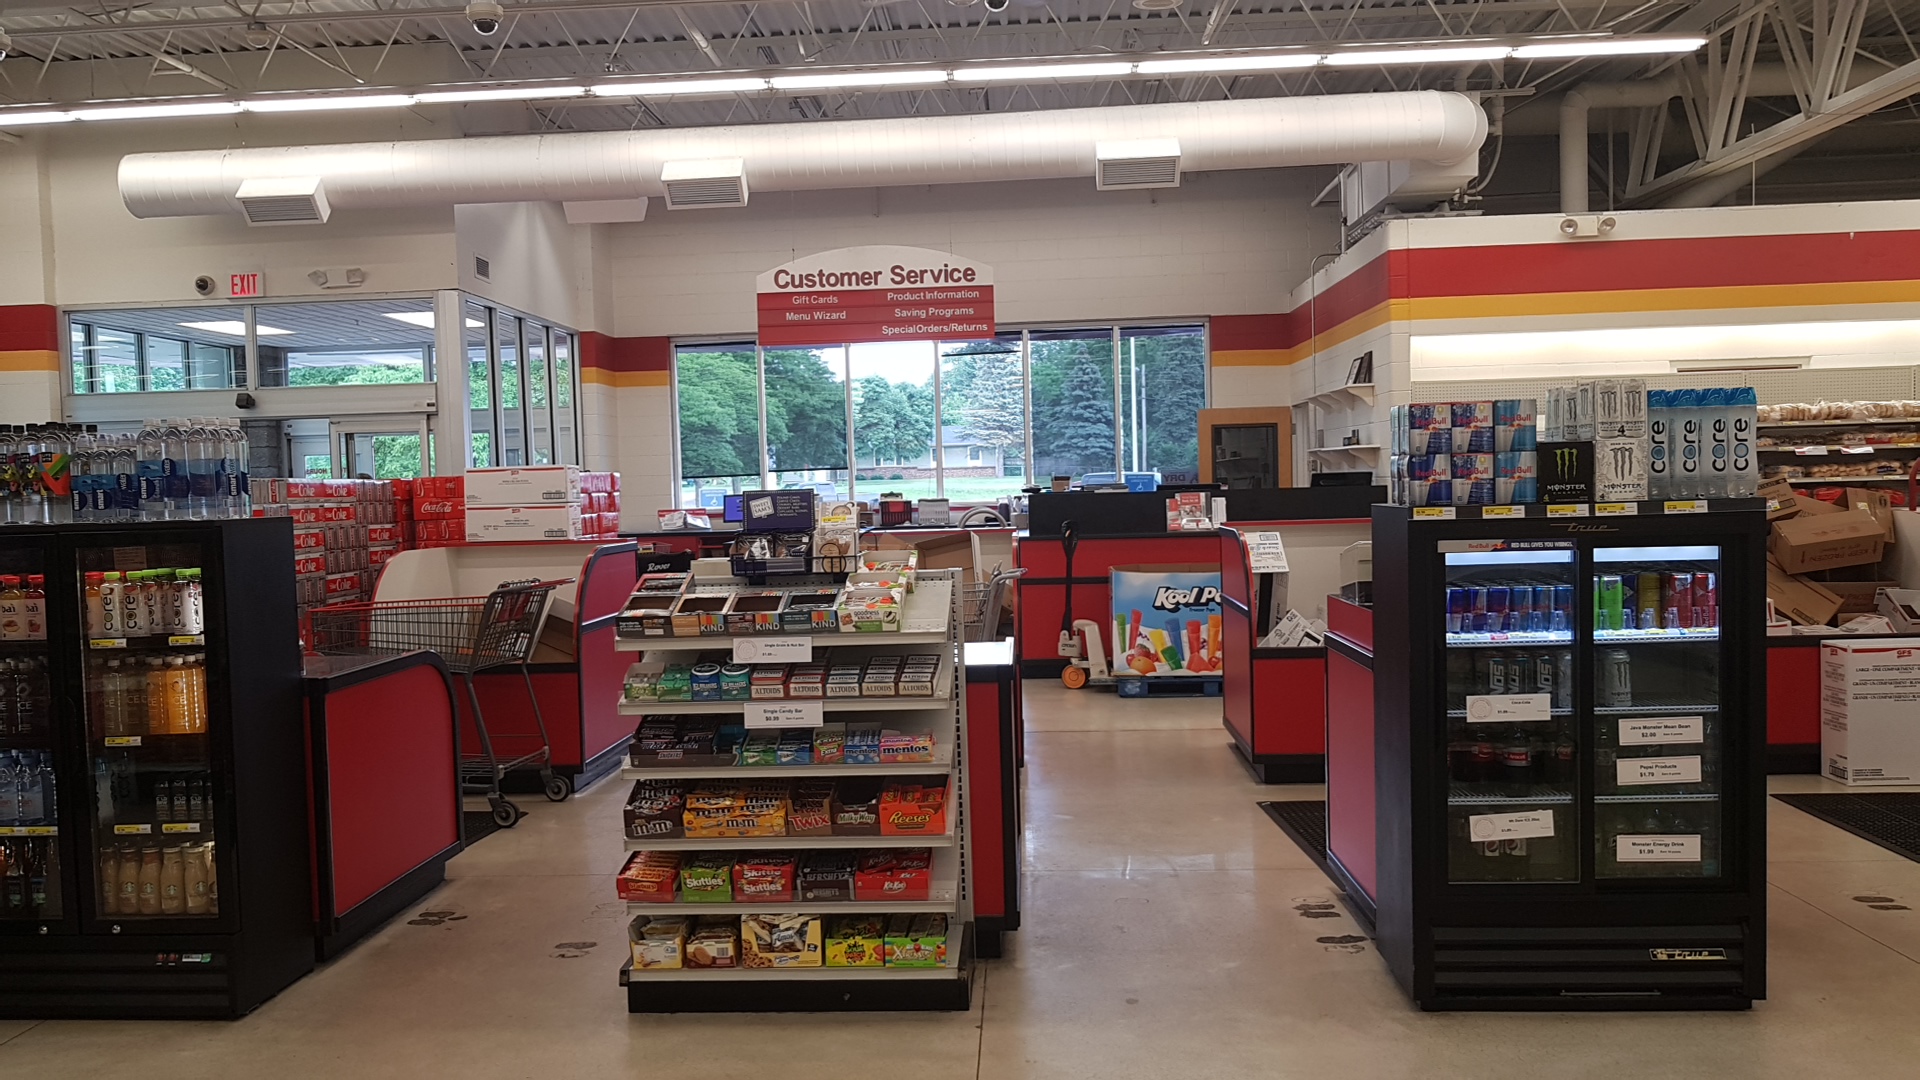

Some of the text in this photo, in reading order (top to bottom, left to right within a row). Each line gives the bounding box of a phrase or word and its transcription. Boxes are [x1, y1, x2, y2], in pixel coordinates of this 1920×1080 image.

[774, 264, 976, 289] Customer Service
[230, 274, 258, 296] EXIT
[792, 295, 838, 304] Gift Cards
[887, 290, 979, 301] Product Information
[786, 310, 846, 321] Menu Wizard
[894, 307, 974, 319] Saving Programs
[1651, 420, 1666, 474] core
[1682, 420, 1696, 473] core
[1712, 418, 1726, 472] core
[1734, 418, 1749, 472] core
[421, 502, 452, 513] Coca-Cola
[647, 563, 670, 572] Rover
[1154, 587, 1197, 609] Kool
[104, 596, 113, 631] core
[125, 596, 137, 629] core
[700, 623, 724, 632] KIND
[756, 623, 780, 631] KIND
[812, 620, 836, 628] KIND
[883, 744, 928, 754] mentos
[686, 878, 724, 888] Skittles
[744, 884, 782, 894] Skittles
